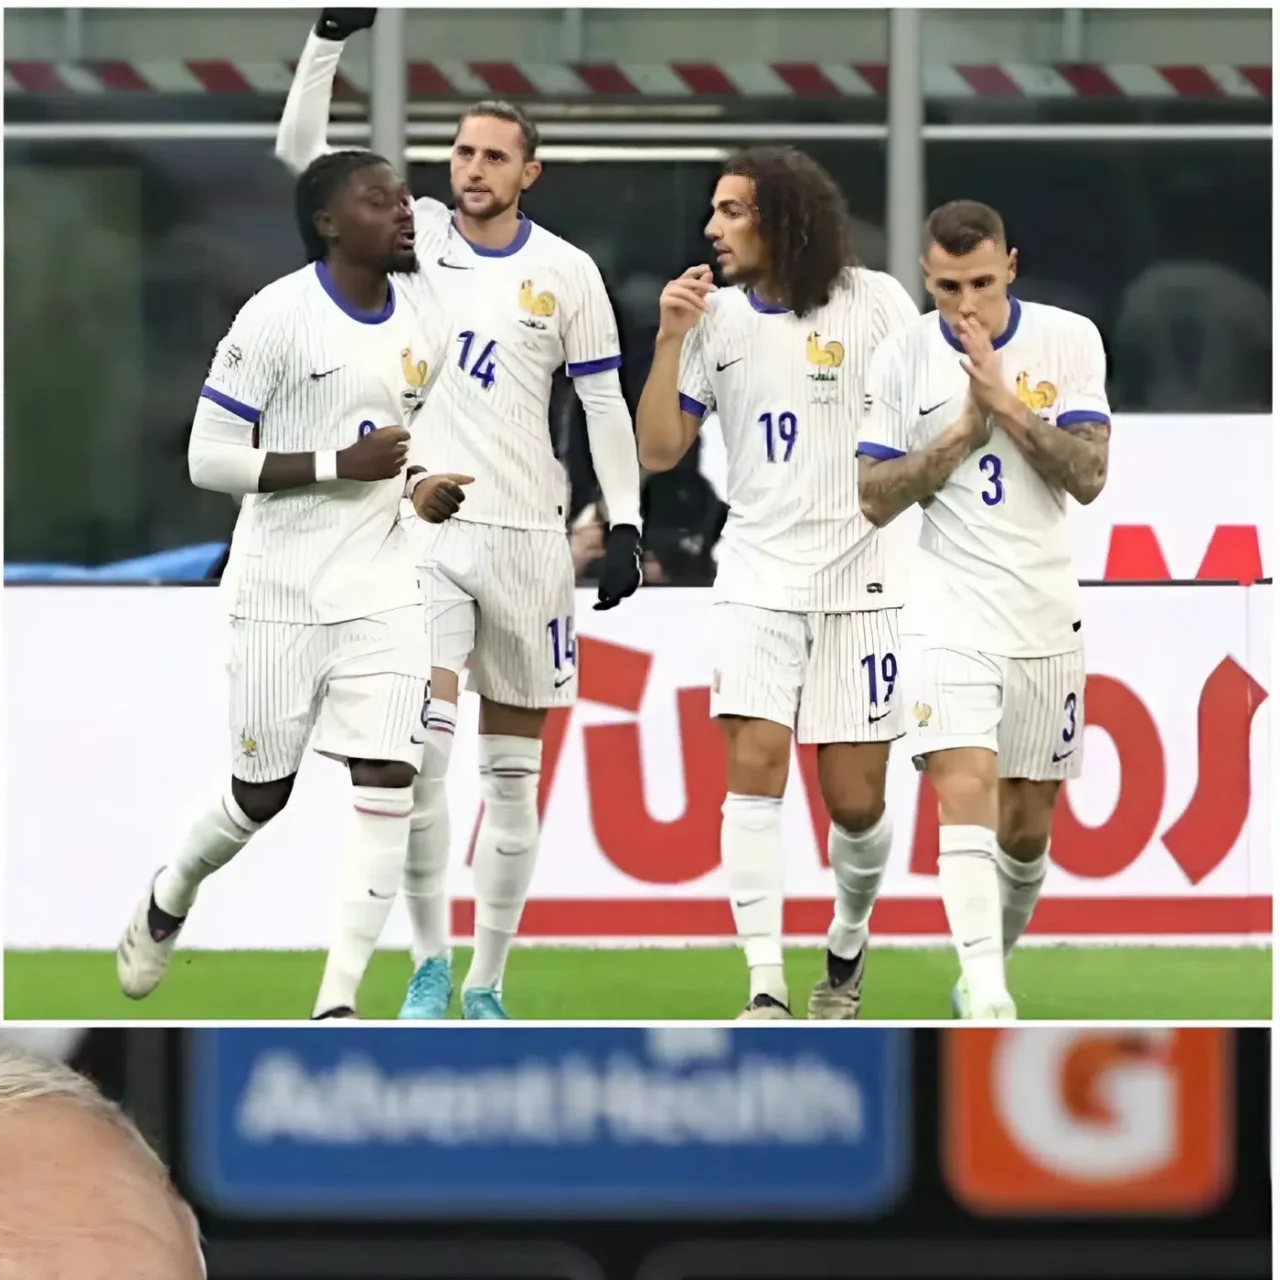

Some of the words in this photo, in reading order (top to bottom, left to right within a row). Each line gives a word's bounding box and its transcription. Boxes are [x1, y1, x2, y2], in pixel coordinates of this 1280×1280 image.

[457, 330, 497, 391] 14
[757, 411, 798, 462] 19
[978, 454, 1004, 505] 3
[861, 652, 898, 706] 19
[1061, 692, 1079, 743] 3
[988, 1028, 1184, 1183] G
